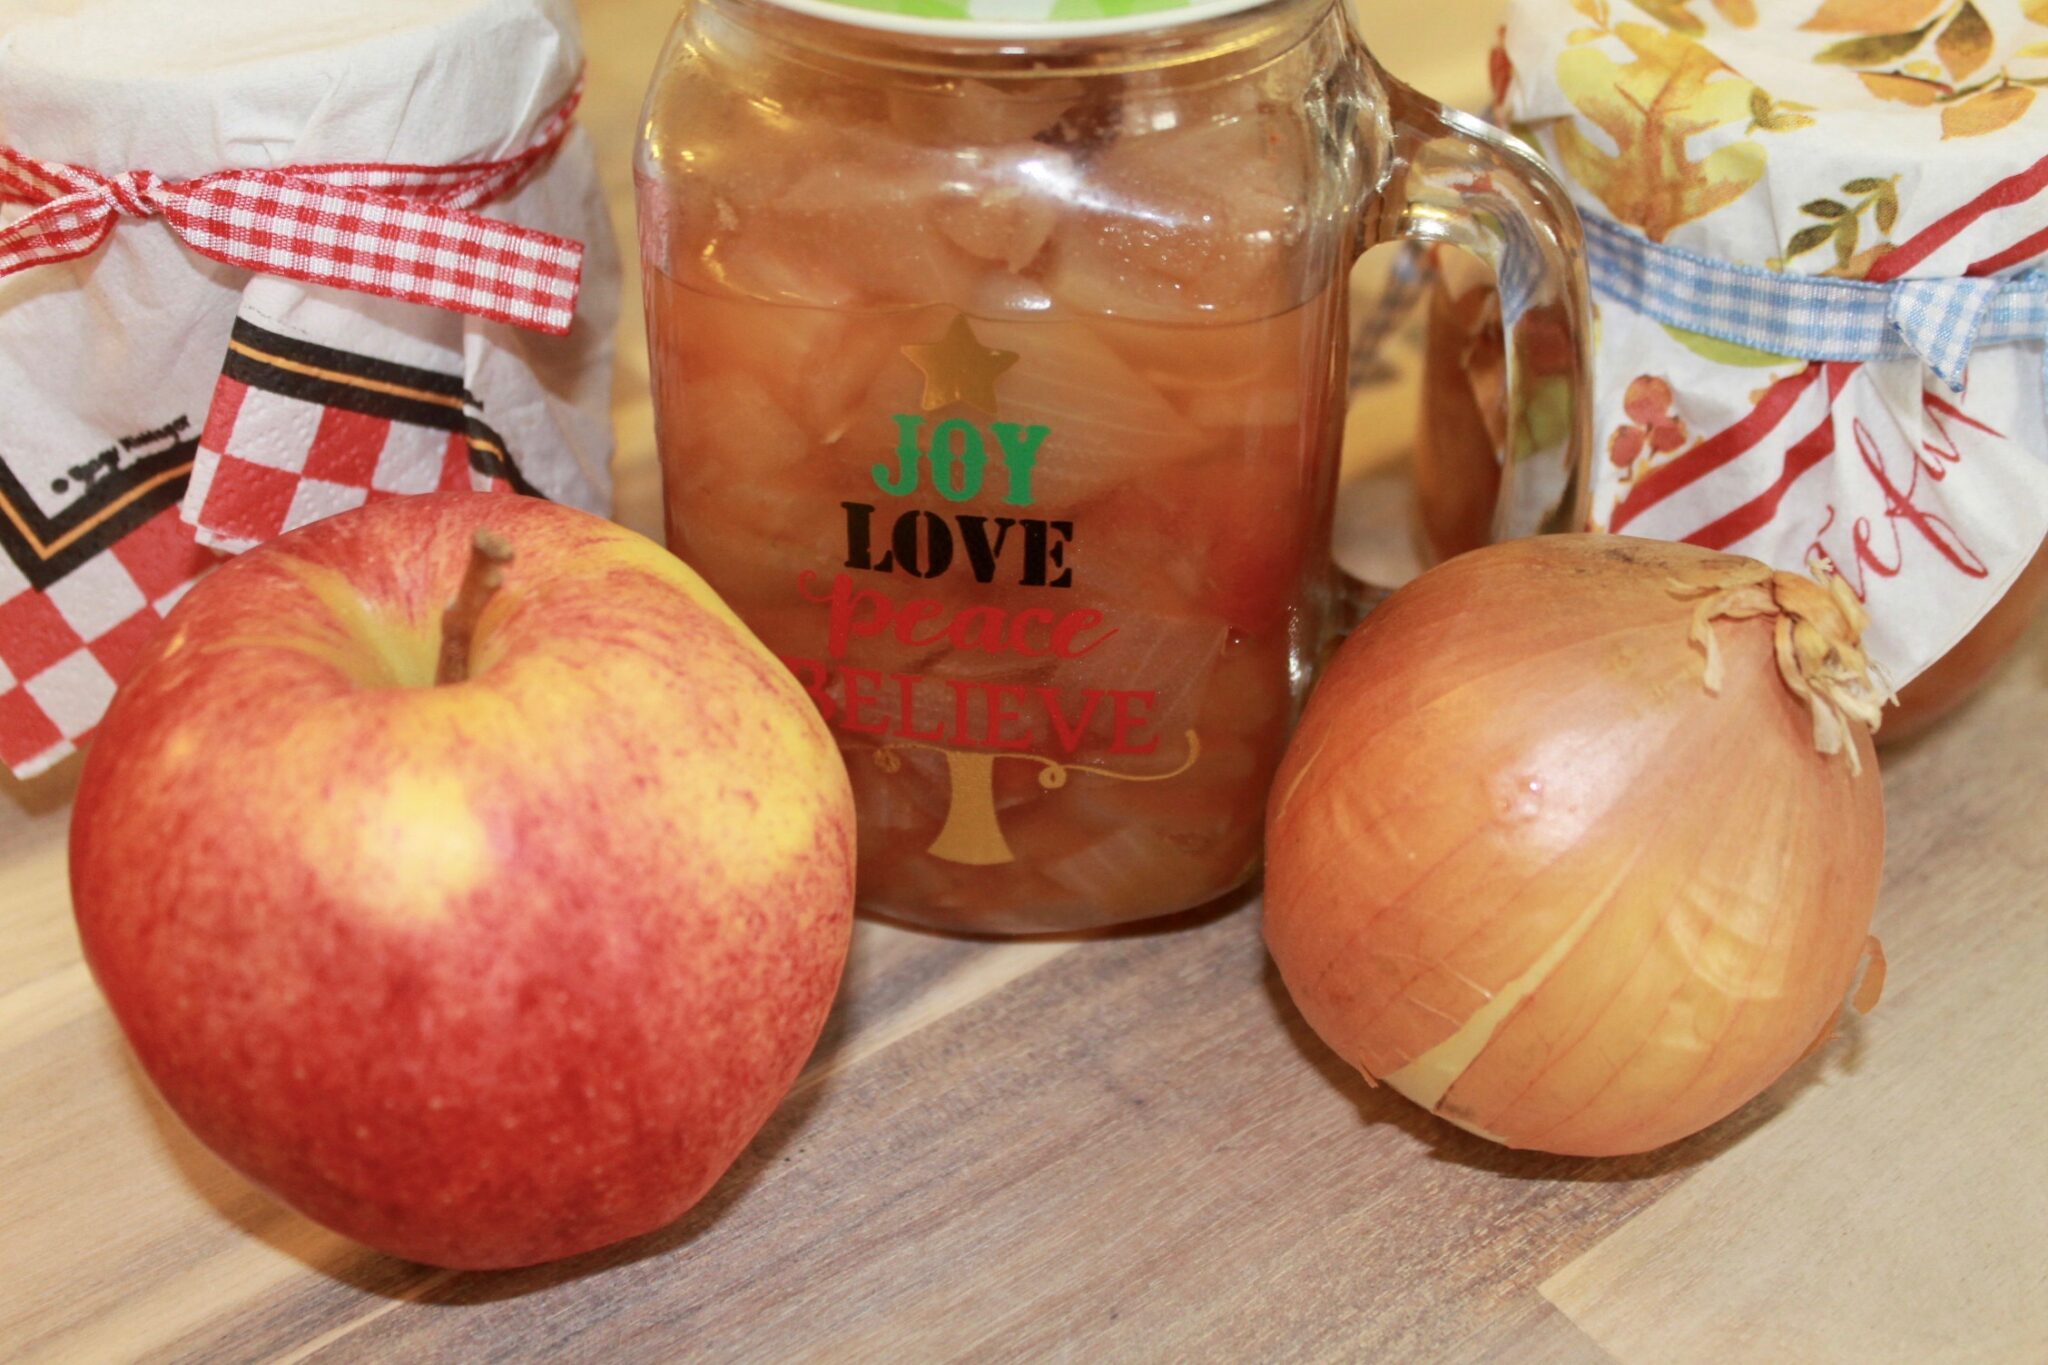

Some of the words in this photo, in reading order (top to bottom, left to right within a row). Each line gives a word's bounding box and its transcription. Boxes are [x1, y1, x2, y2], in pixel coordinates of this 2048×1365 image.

[871, 413, 1052, 507] JOY
[841, 501, 1073, 588] LOVE
[797, 569, 1120, 660] peace
